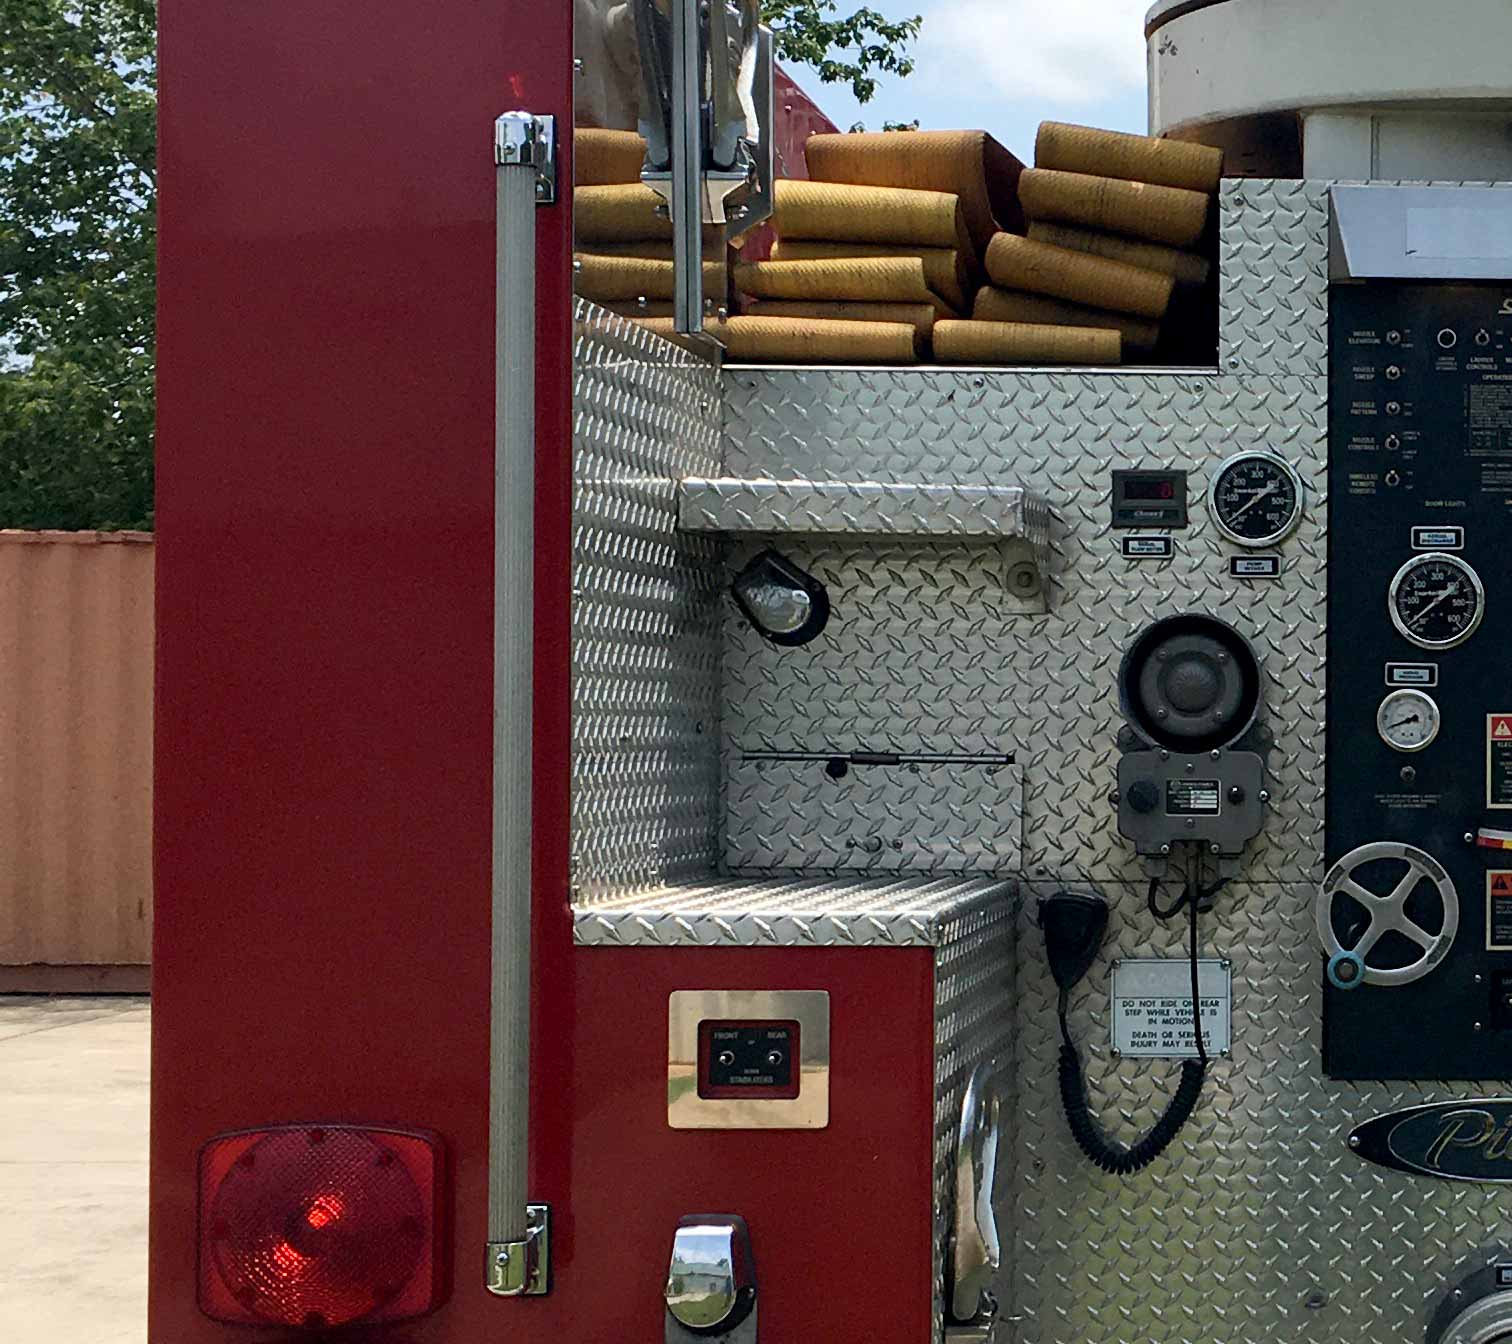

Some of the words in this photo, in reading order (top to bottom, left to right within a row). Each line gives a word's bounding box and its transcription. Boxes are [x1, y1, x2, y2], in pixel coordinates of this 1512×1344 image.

[1233, 478, 1246, 486] 200
[1227, 494, 1238, 502] 100
[1272, 497, 1284, 505] 500
[1431, 572, 1444, 580] 300
[1408, 596, 1419, 604] 100
